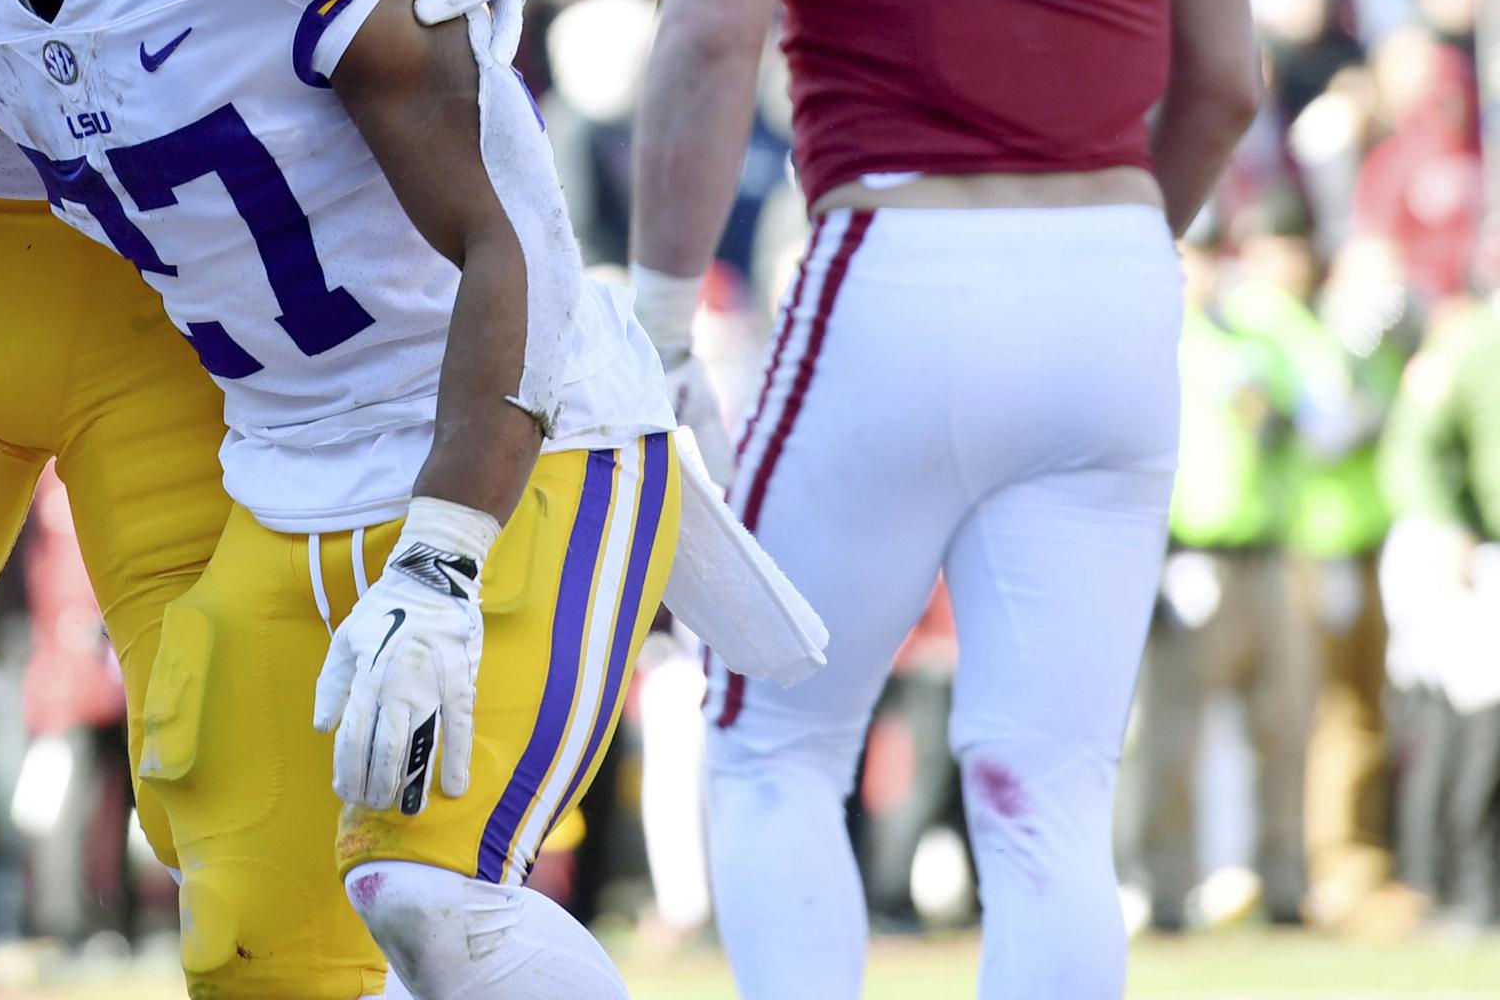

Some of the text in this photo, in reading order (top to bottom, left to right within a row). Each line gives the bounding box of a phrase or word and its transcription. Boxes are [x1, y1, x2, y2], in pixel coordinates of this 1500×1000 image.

[44, 43, 75, 82] SEC
[66, 110, 112, 139] LSU
[17, 102, 376, 380] 27
